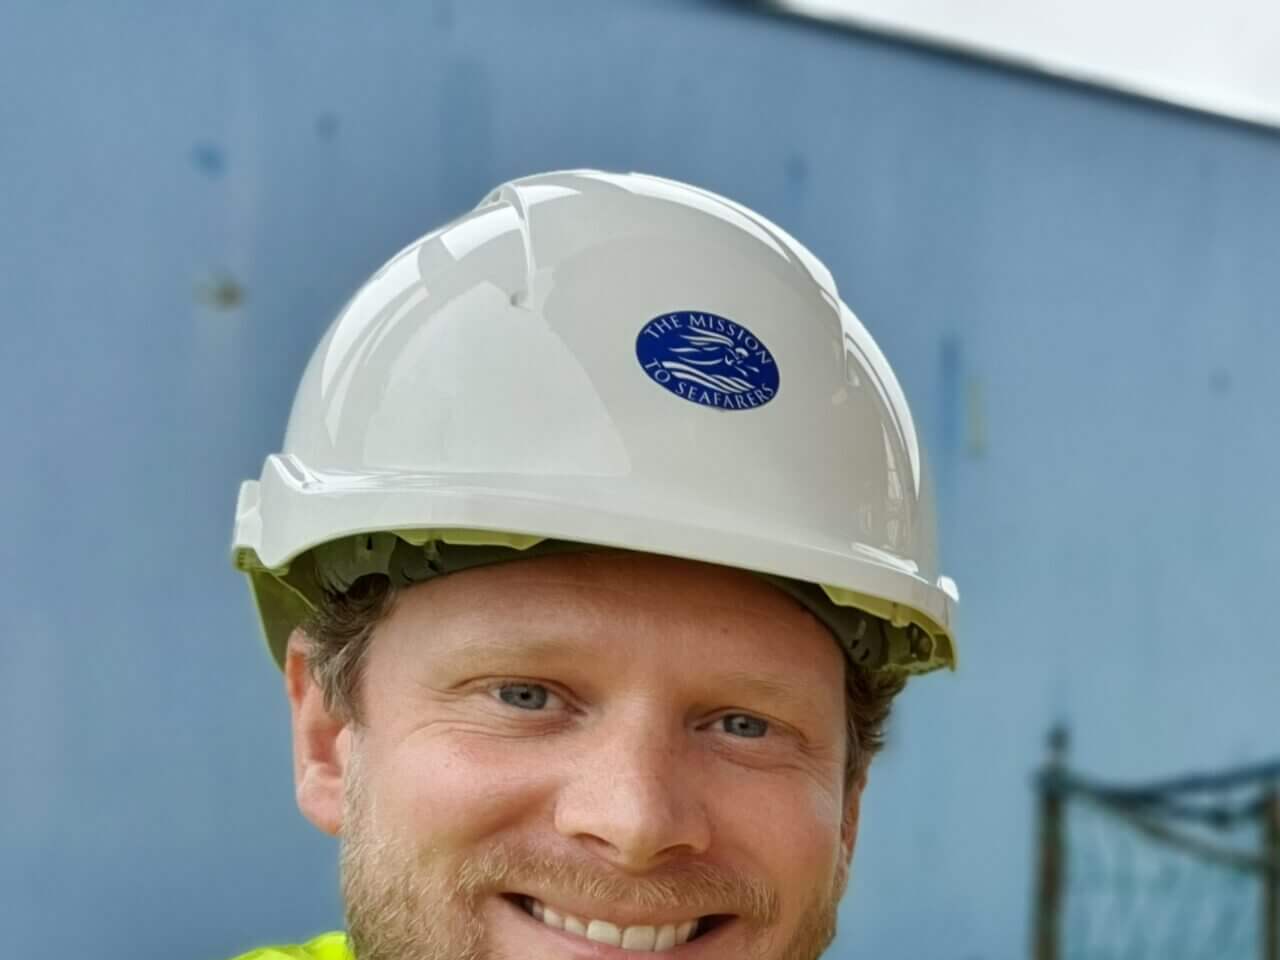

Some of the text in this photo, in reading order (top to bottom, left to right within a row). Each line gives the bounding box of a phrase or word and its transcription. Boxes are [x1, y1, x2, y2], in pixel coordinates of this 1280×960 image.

[643, 313, 773, 365] THE MISSION
[644, 357, 774, 409] TO SEAFARERS
